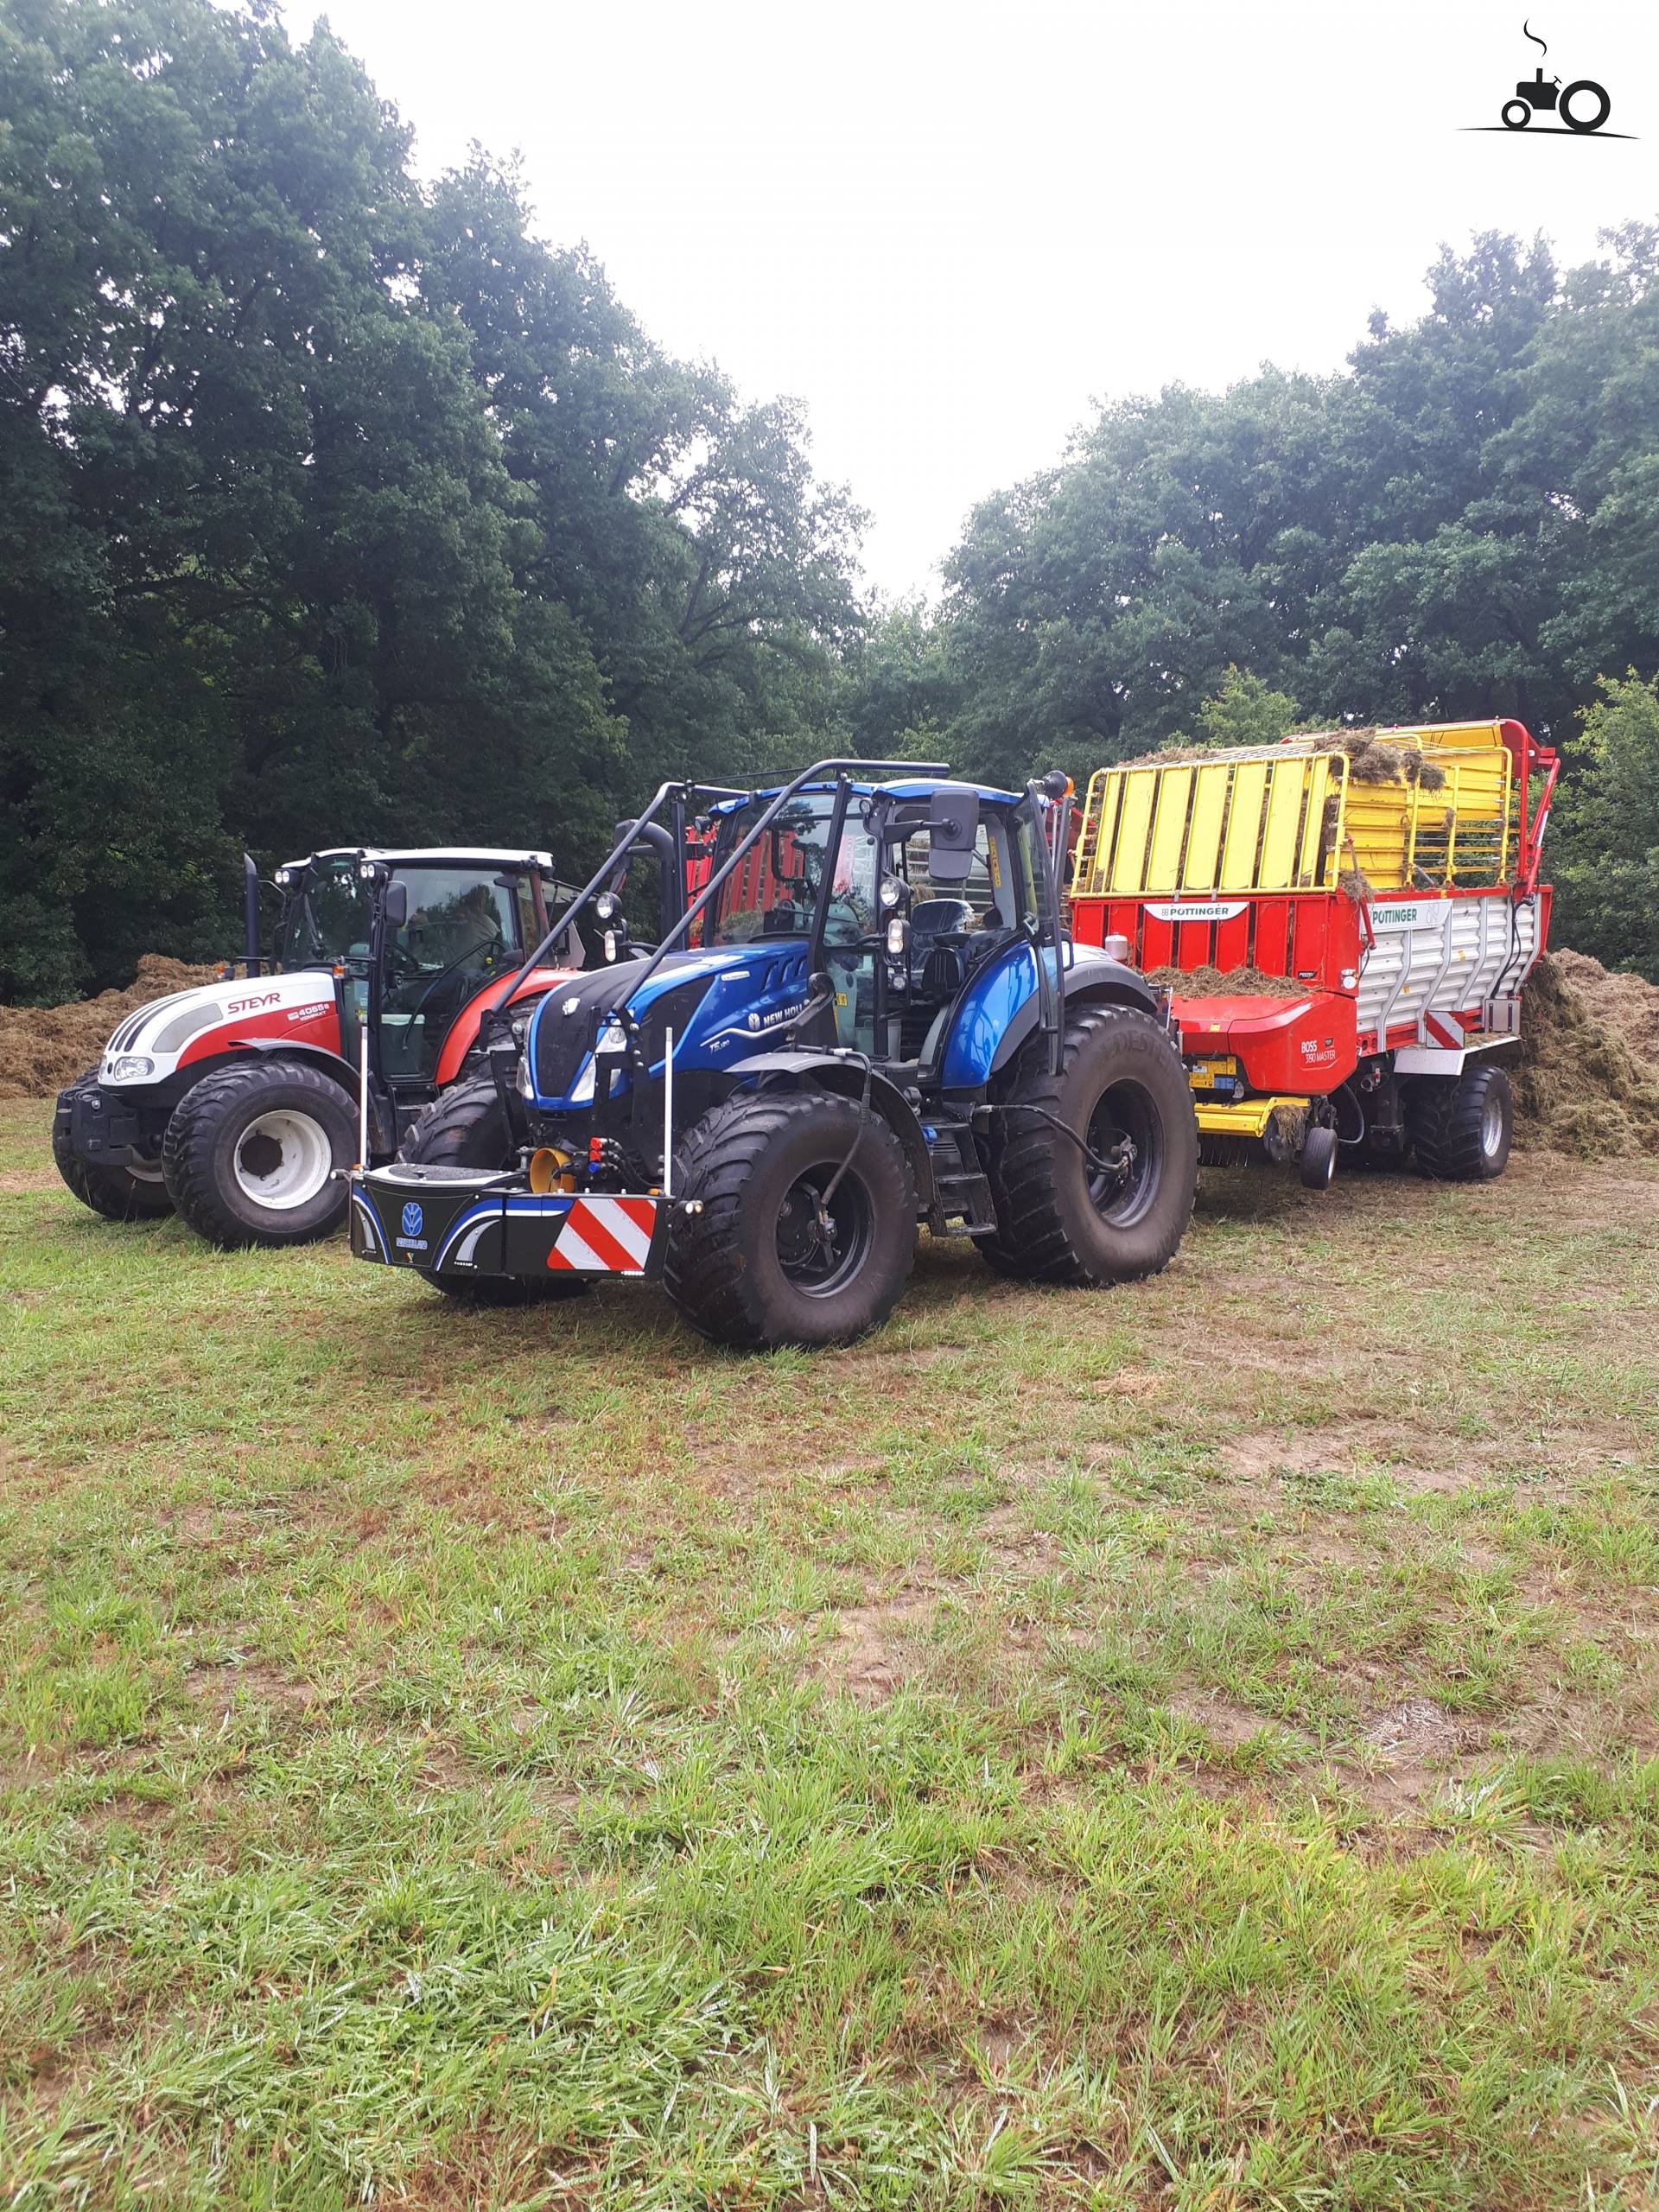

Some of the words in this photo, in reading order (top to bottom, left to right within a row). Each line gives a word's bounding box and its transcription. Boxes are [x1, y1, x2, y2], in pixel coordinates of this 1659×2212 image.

[228, 993, 281, 1014] STEYR
[763, 1009, 784, 1027] NEW
[1301, 1040, 1317, 1053] BOSS
[1317, 1050, 1336, 1062] MASTER
